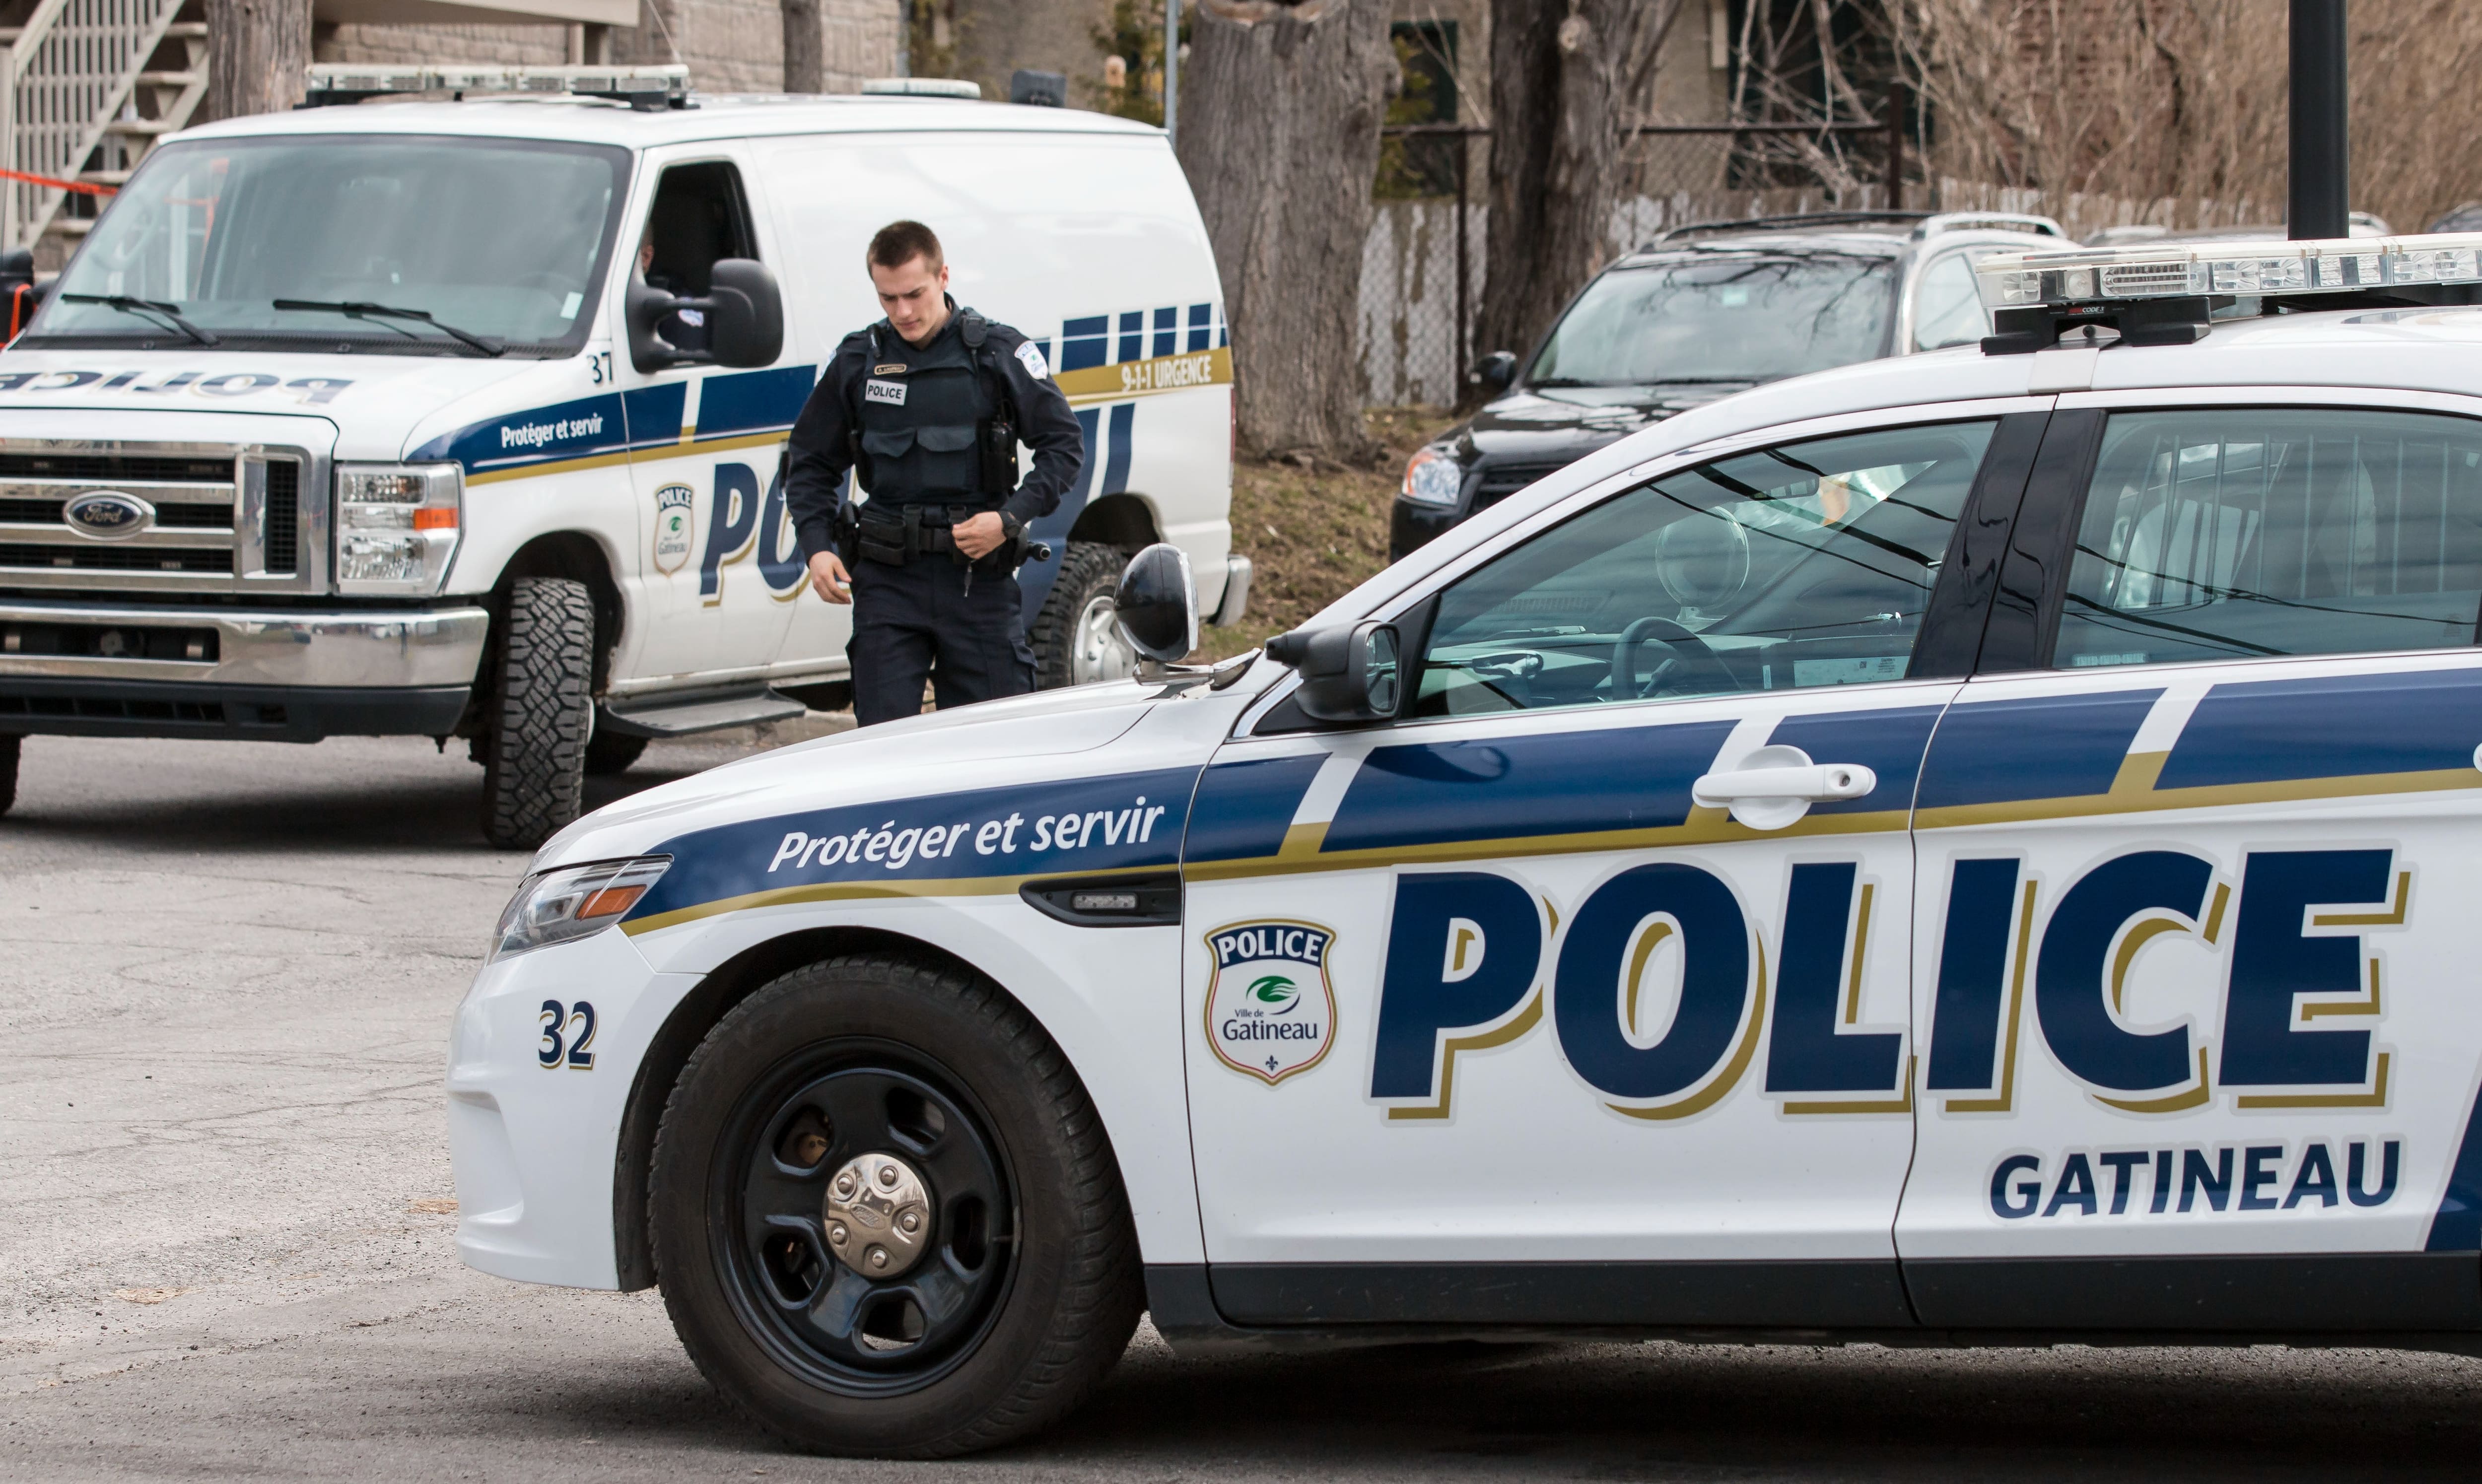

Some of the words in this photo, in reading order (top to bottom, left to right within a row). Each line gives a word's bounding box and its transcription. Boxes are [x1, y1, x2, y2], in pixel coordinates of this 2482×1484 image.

[586, 351, 614, 386] 37
[1121, 363, 1152, 394] 9-1-1
[1155, 355, 1212, 389] URGENCE
[867, 385, 902, 399] POLICE
[501, 422, 554, 448] Protéger
[555, 419, 569, 440] et
[570, 412, 604, 438] servir
[83, 503, 124, 523] Ford
[658, 488, 691, 510] POLICE
[767, 820, 969, 873] Protéger
[974, 812, 1024, 855] et
[1030, 796, 1165, 851] servir
[1217, 929, 1323, 964] POLICE
[1370, 849, 2411, 1121] POLICE
[1223, 1019, 1318, 1041] Gatineau
[1235, 1009, 1252, 1017] Ville
[1254, 1009, 1264, 1017] de
[538, 999, 598, 1071] 32
[1988, 1140, 2401, 1219] GATINEAU
